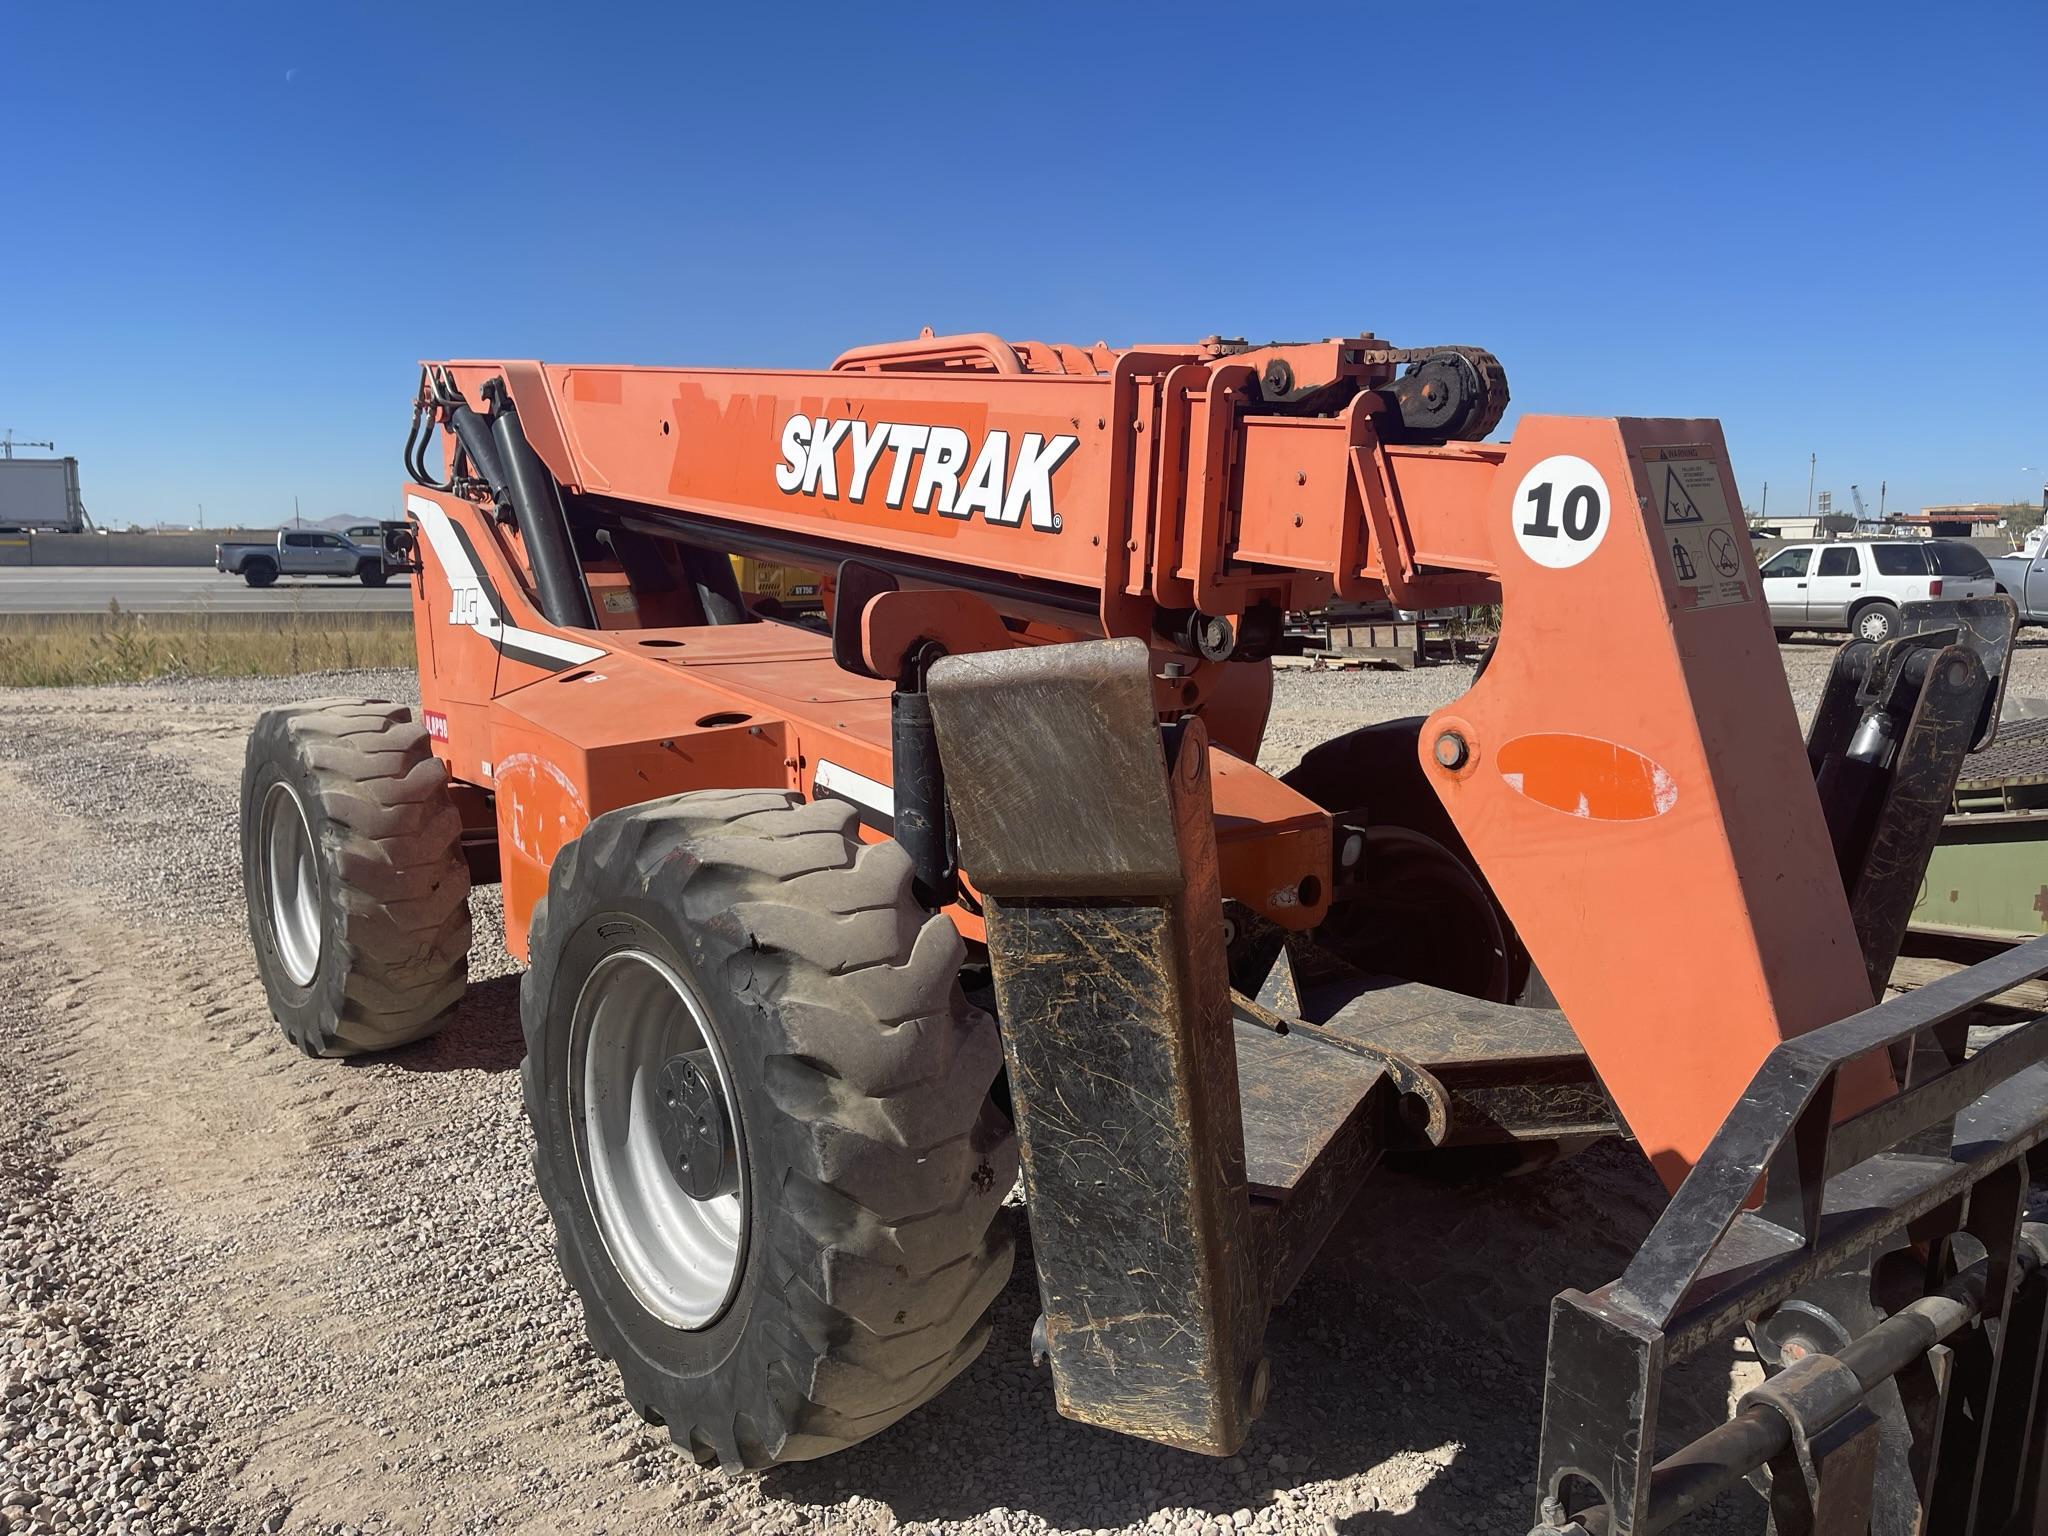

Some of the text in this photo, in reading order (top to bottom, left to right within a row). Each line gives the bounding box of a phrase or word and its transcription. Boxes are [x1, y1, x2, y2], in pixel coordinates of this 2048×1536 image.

[775, 414, 1080, 533] SKYTRAK
[1523, 482, 1601, 541] 10
[449, 588, 479, 626] JLG
